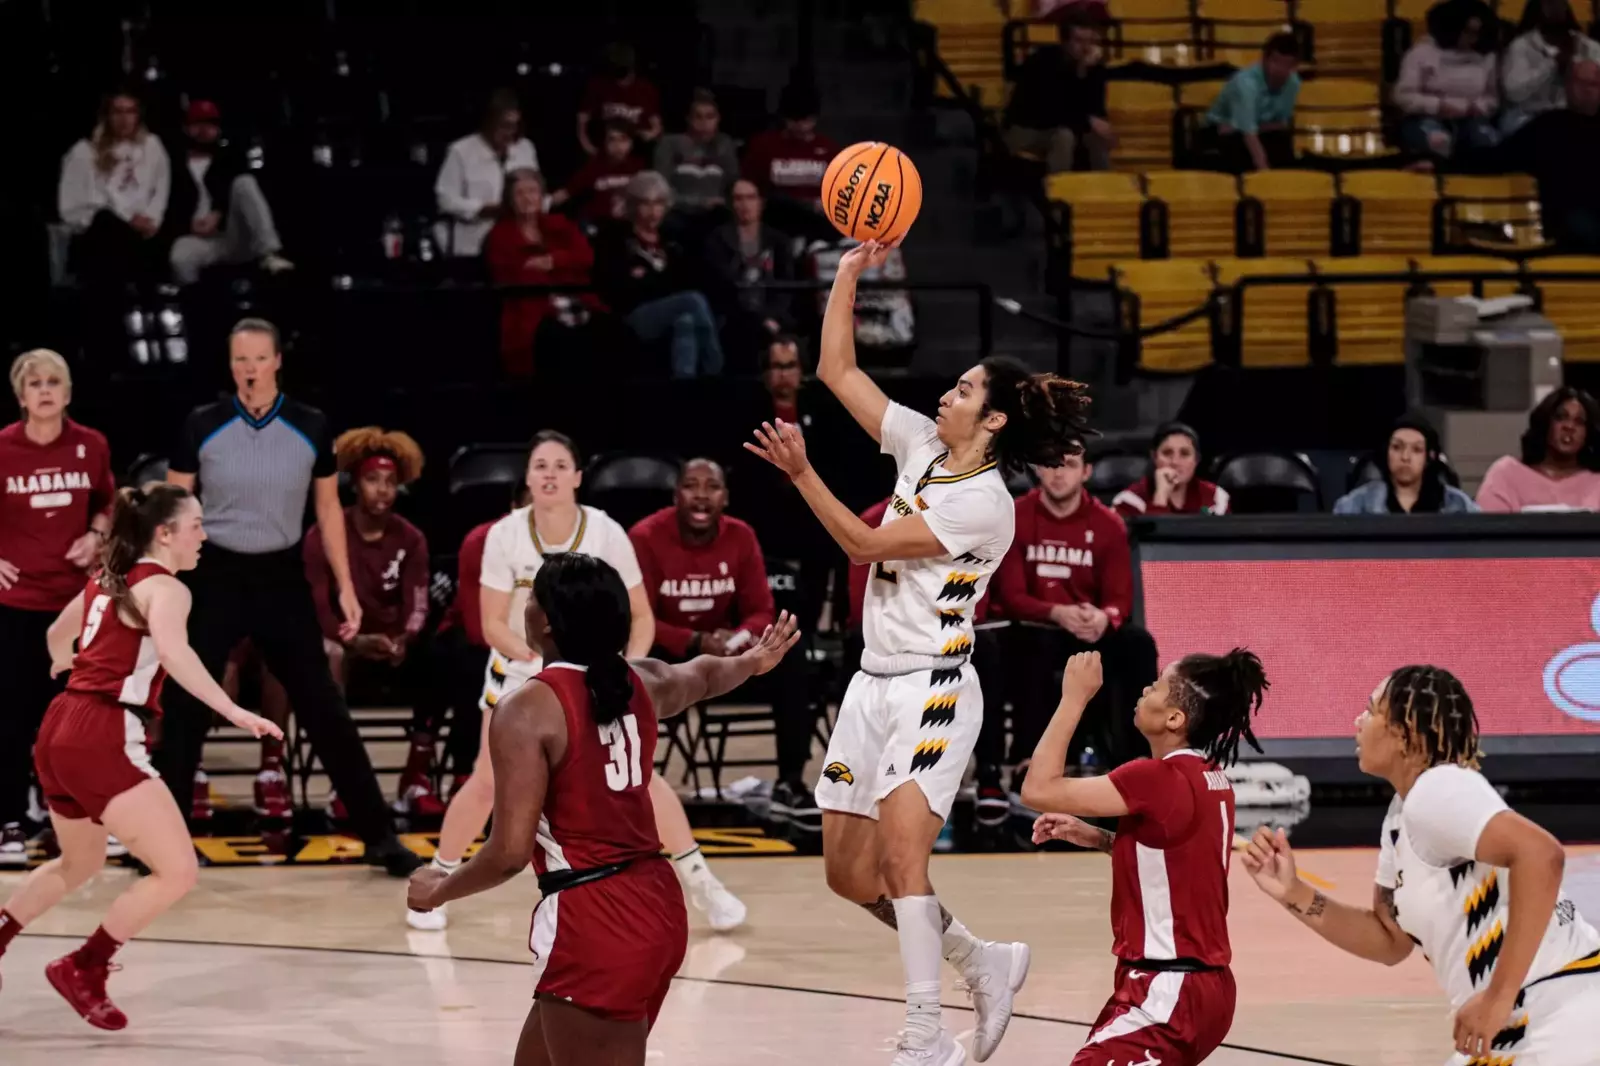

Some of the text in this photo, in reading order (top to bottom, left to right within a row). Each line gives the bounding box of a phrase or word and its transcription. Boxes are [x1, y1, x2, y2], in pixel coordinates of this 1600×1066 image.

[834, 163, 867, 226] Wilson
[864, 182, 893, 230] NCAA
[6, 471, 92, 494] ALABAMA
[659, 576, 736, 597] ALABAMA
[81, 594, 112, 650] 5
[598, 713, 642, 791] 31
[1219, 800, 1229, 870] 1
